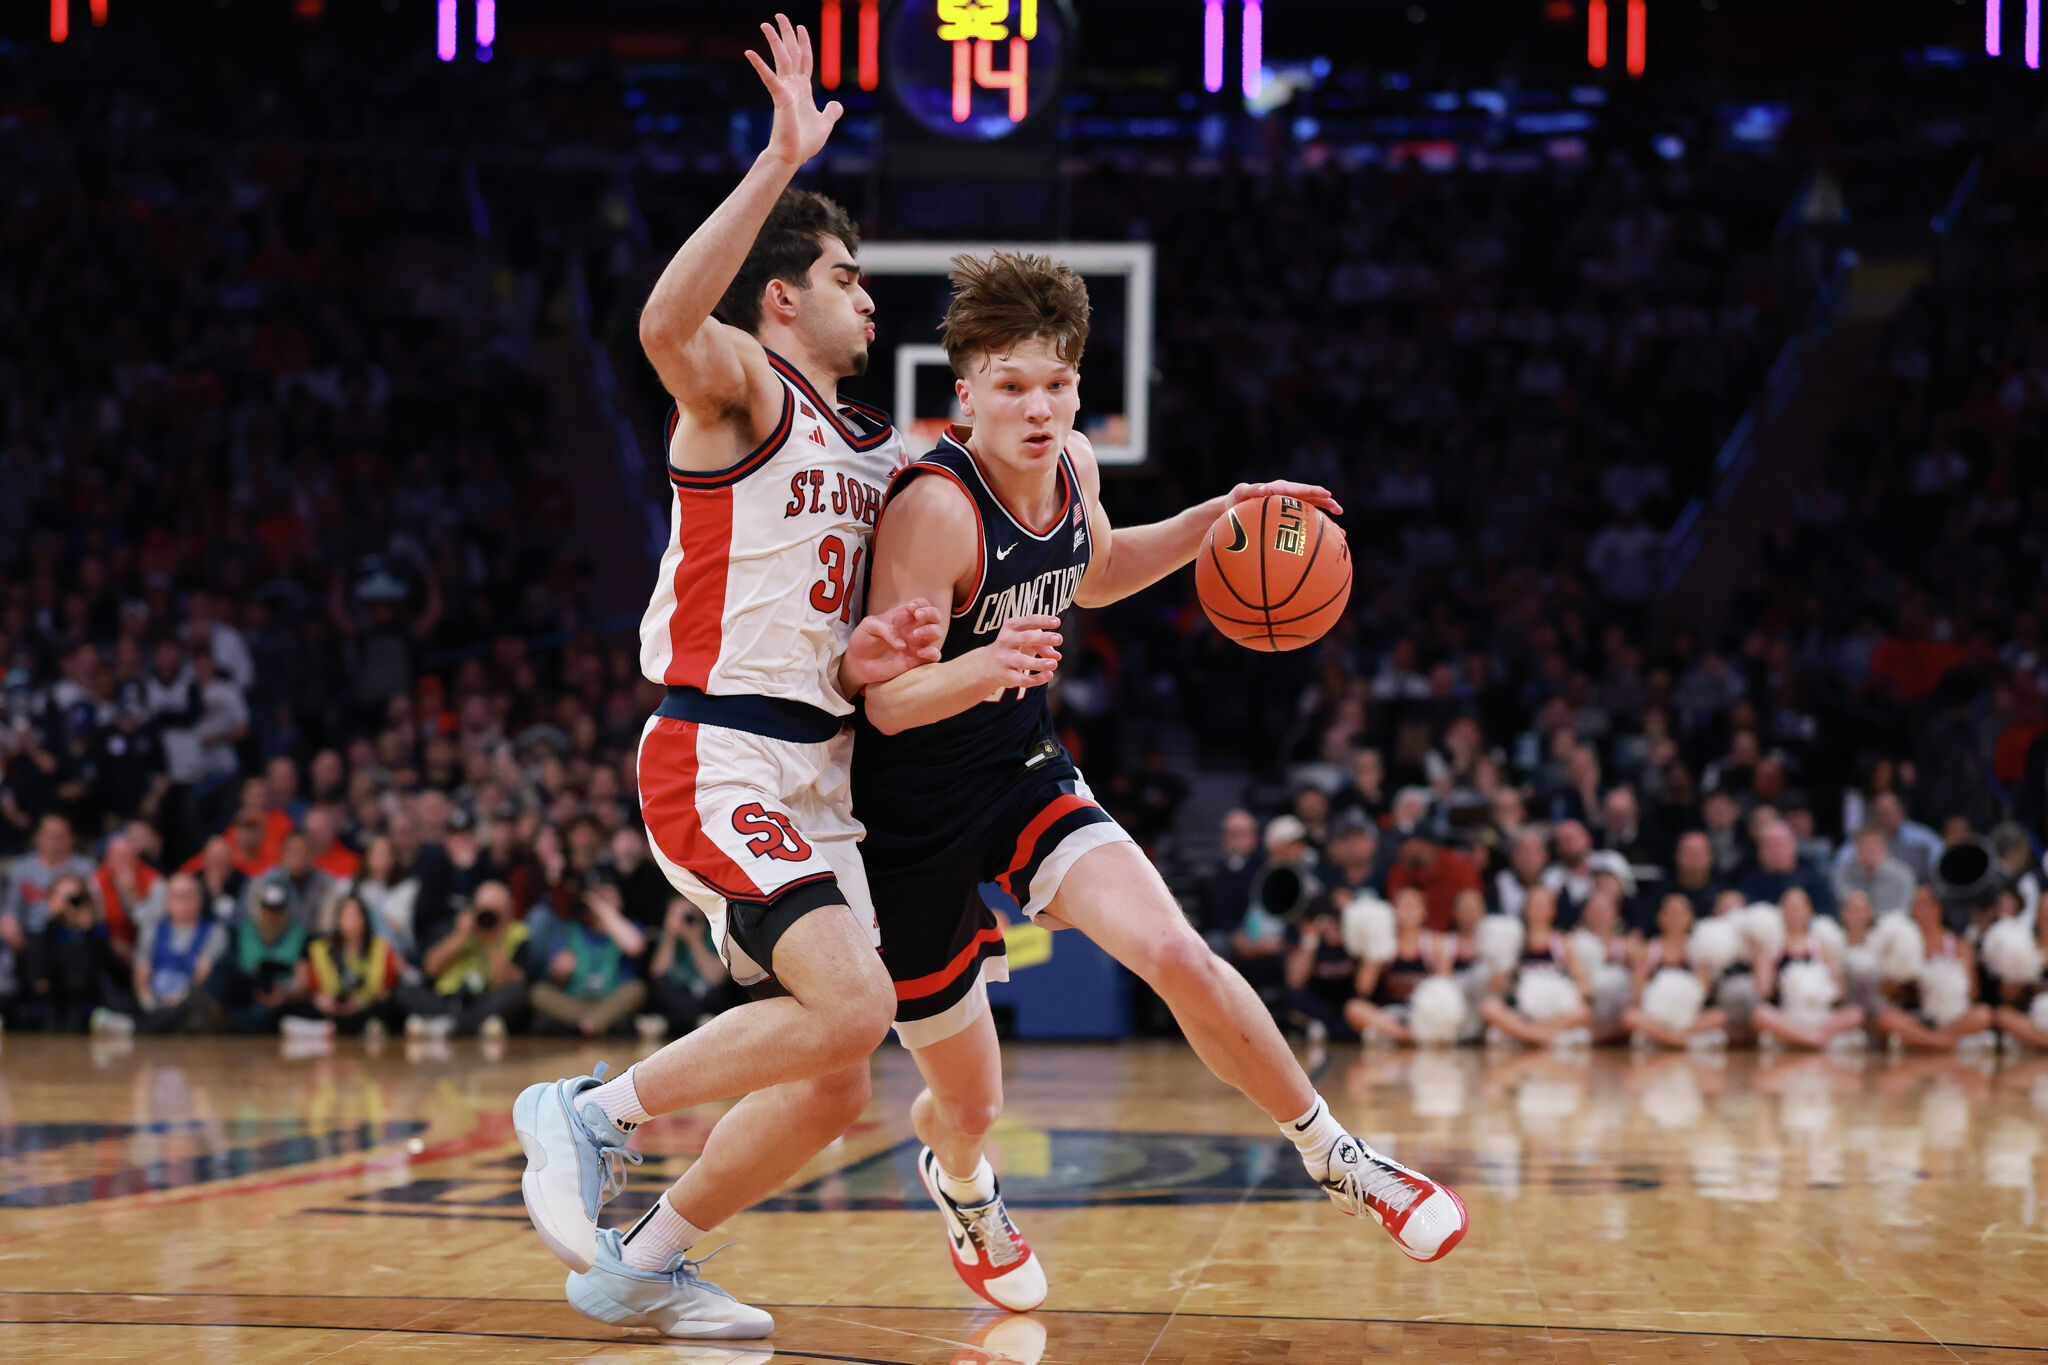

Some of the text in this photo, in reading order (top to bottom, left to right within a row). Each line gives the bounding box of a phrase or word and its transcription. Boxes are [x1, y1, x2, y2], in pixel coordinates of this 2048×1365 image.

[952, 36, 1028, 123] 14
[784, 469, 887, 528] ST. JOH
[1274, 496, 1302, 554] ELITE
[809, 535, 863, 624] 31
